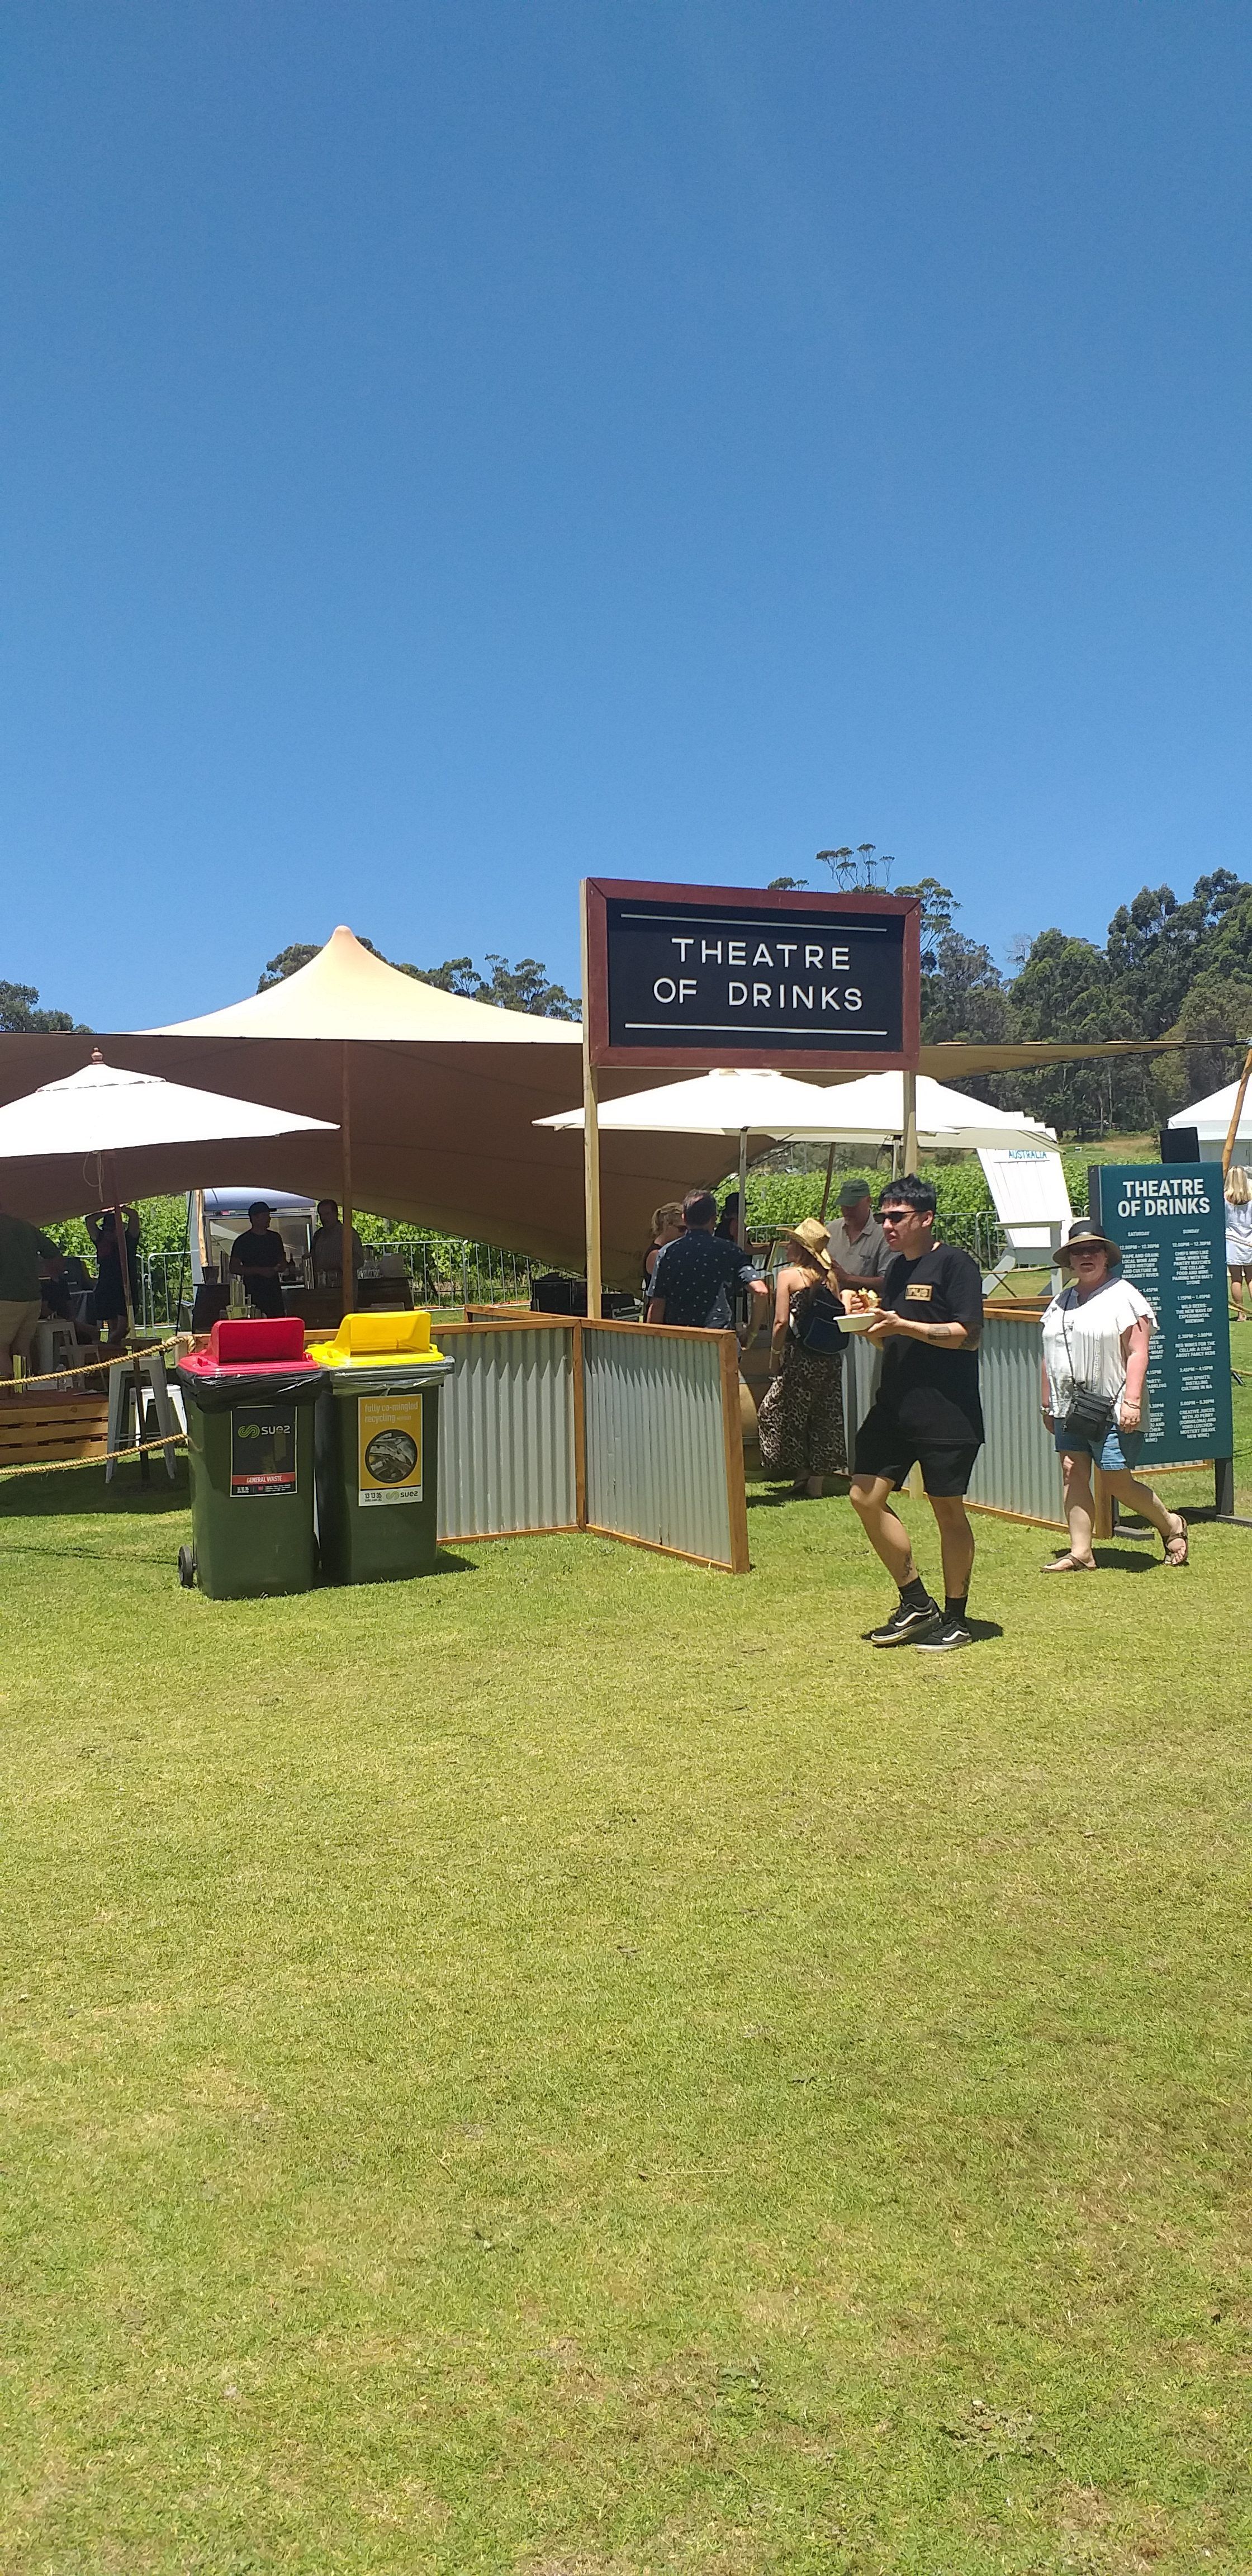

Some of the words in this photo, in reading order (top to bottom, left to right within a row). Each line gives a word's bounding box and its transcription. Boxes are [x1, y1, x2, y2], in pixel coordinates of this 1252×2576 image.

[671, 937, 850, 970] THEATRE
[653, 977, 698, 1004] OF
[728, 981, 863, 1011] DRINKS
[1008, 1149, 1047, 1159] AUSTRALIA
[1122, 1178, 1204, 1198] THEATRE
[1118, 1200, 1141, 1218] OF
[1145, 1197, 1210, 1216] DRINKS
[365, 1404, 380, 1413] fully
[382, 1401, 418, 1412] co-mingled
[365, 1413, 396, 1424] recycling
[261, 1425, 291, 1435] suez
